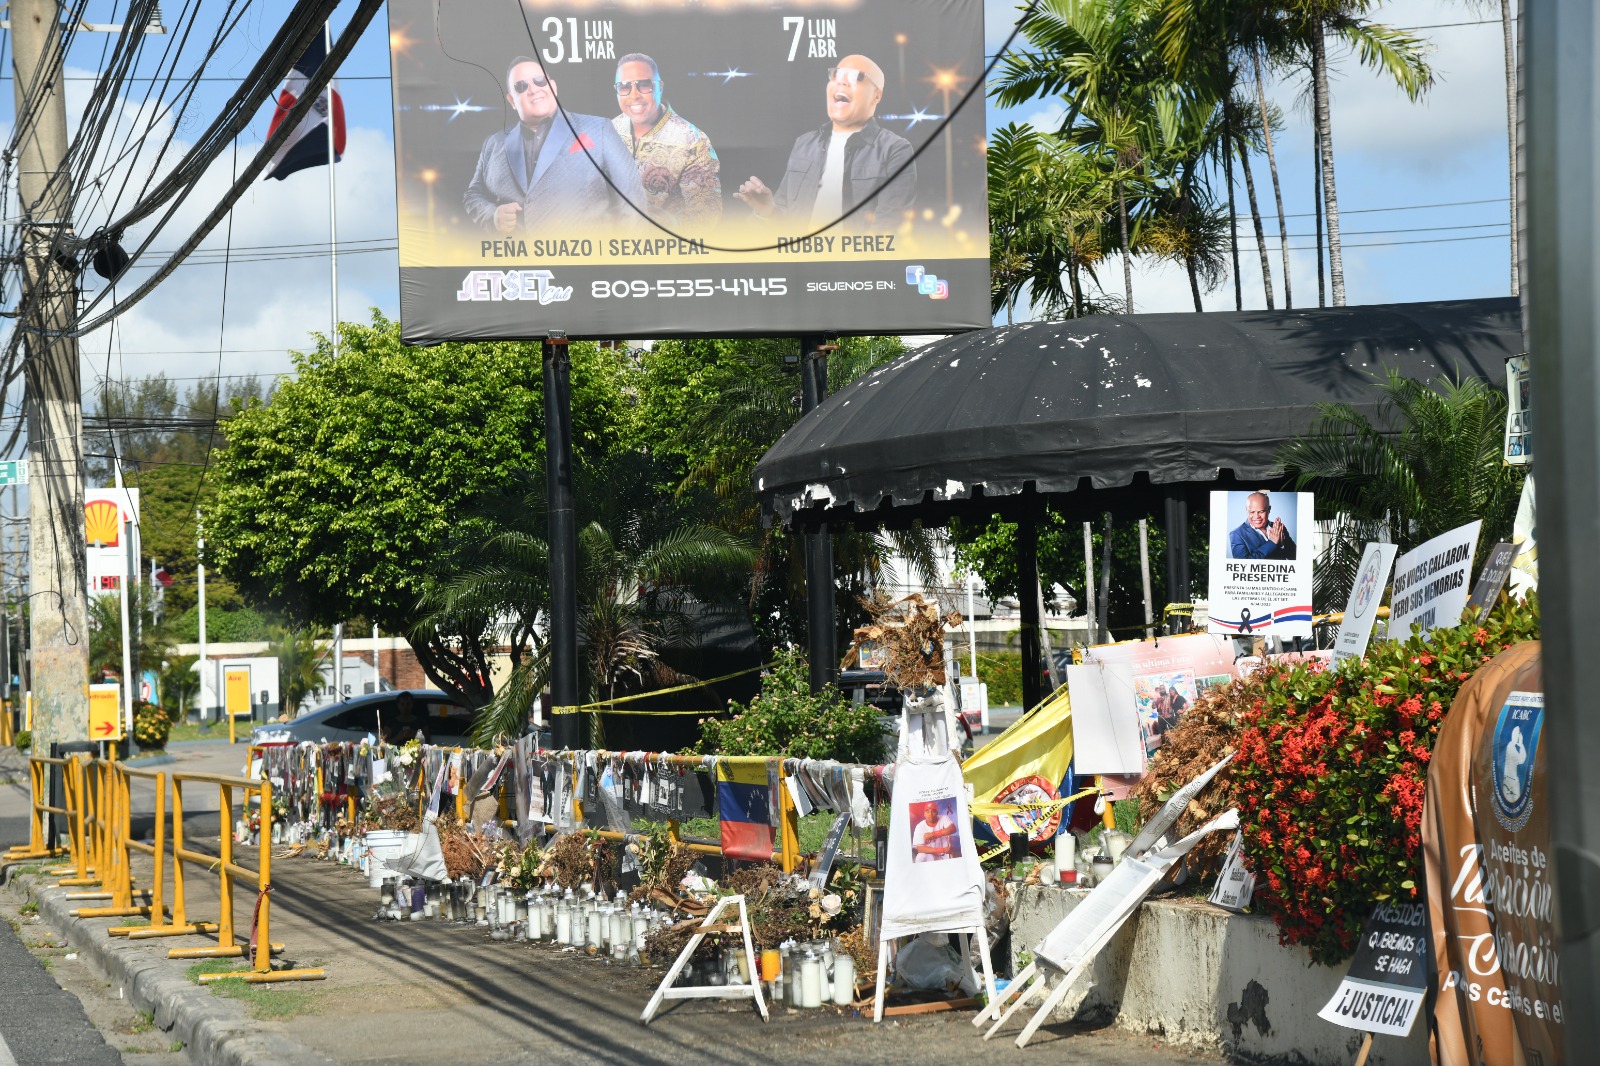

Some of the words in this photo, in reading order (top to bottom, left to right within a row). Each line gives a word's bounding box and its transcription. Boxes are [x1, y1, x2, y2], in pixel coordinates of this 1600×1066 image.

[584, 21, 613, 39] LUN
[783, 16, 804, 61] 7
[808, 19, 836, 38] LUN
[542, 17, 582, 64] 31
[585, 41, 616, 59] MAR
[808, 39, 837, 58] ABR
[481, 236, 528, 258] PEÑA
[533, 239, 592, 257] SUAZO
[609, 238, 709, 256] SEXAPPEAL
[777, 236, 836, 254] RUBBY
[841, 234, 895, 253] PEREZ
[541, 285, 573, 306] Club
[591, 277, 788, 298] 809-535-4145
[806, 280, 873, 292] SIGUENOS
[876, 280, 896, 290] EN:
[1226, 563, 1247, 572] REY
[1250, 564, 1296, 573] MEDINA
[1232, 573, 1289, 583] PRESENTE
[1394, 574, 1406, 596] SUS
[1406, 561, 1427, 589] VOCES
[1428, 542, 1470, 576] CALLARON,
[1393, 596, 1409, 621] PERO
[1410, 588, 1423, 612] SUS
[1424, 568, 1464, 604] MEMORIAS
[1491, 839, 1529, 867] Aceites
[1531, 845, 1547, 869] de
[1368, 931, 1414, 952] QUEREMOS
[1374, 955, 1390, 972] SE
[1388, 956, 1413, 975] HAGA
[1335, 988, 1414, 1027] ¡JUSTICIA!
